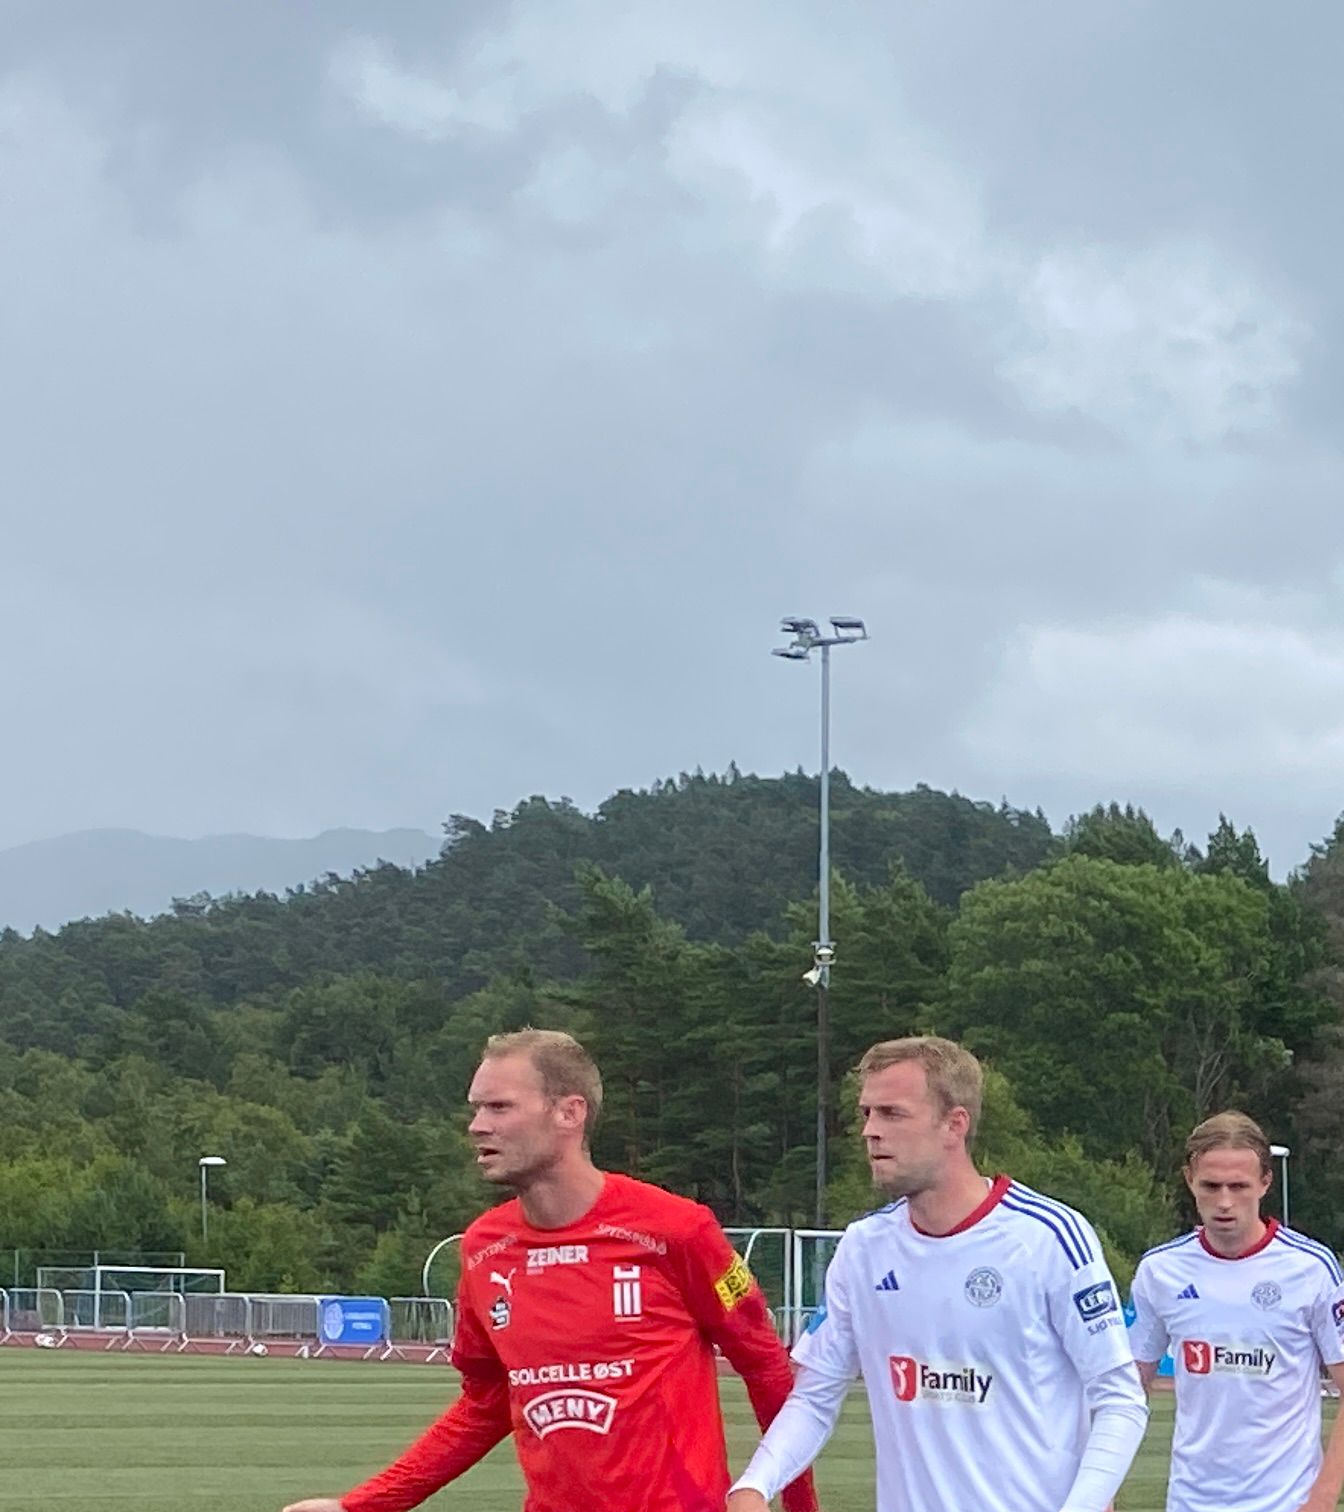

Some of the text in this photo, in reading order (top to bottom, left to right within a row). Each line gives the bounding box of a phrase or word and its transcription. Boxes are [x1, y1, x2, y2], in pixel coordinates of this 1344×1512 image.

[526, 1244, 589, 1268] ZEINER
[507, 1358, 636, 1387] SOLCELLE ØST
[1213, 1346, 1276, 1376] Family
[919, 1363, 993, 1403] Family
[530, 1397, 604, 1428] MENY
